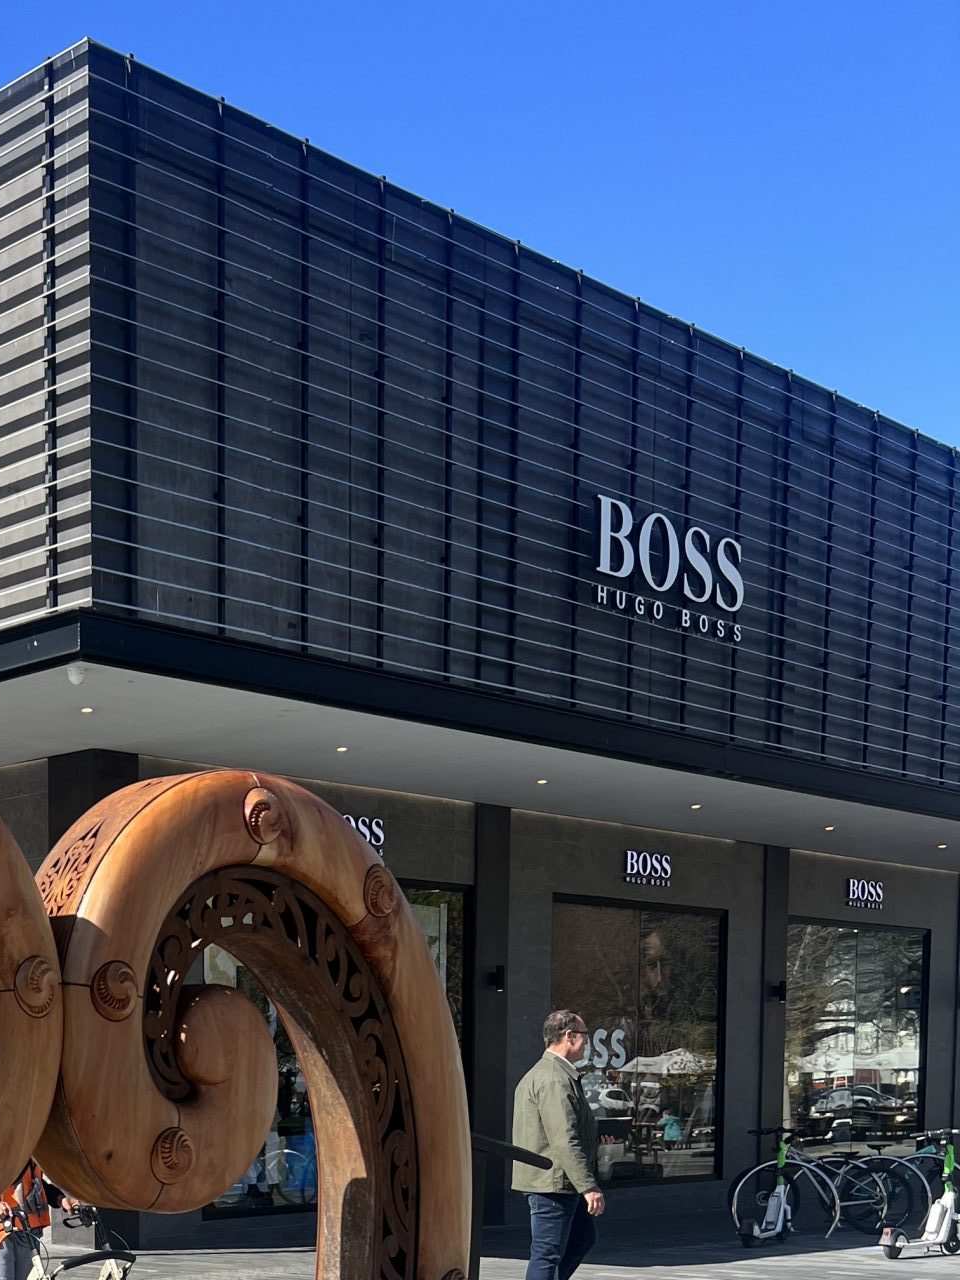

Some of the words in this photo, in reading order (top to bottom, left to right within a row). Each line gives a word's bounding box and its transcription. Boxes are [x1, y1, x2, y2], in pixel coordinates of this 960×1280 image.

[596, 494, 744, 612] BOSS
[597, 585, 664, 620] HUGO
[681, 608, 742, 642] BOSS
[626, 850, 671, 878] BOSS
[849, 878, 884, 902] BOSS
